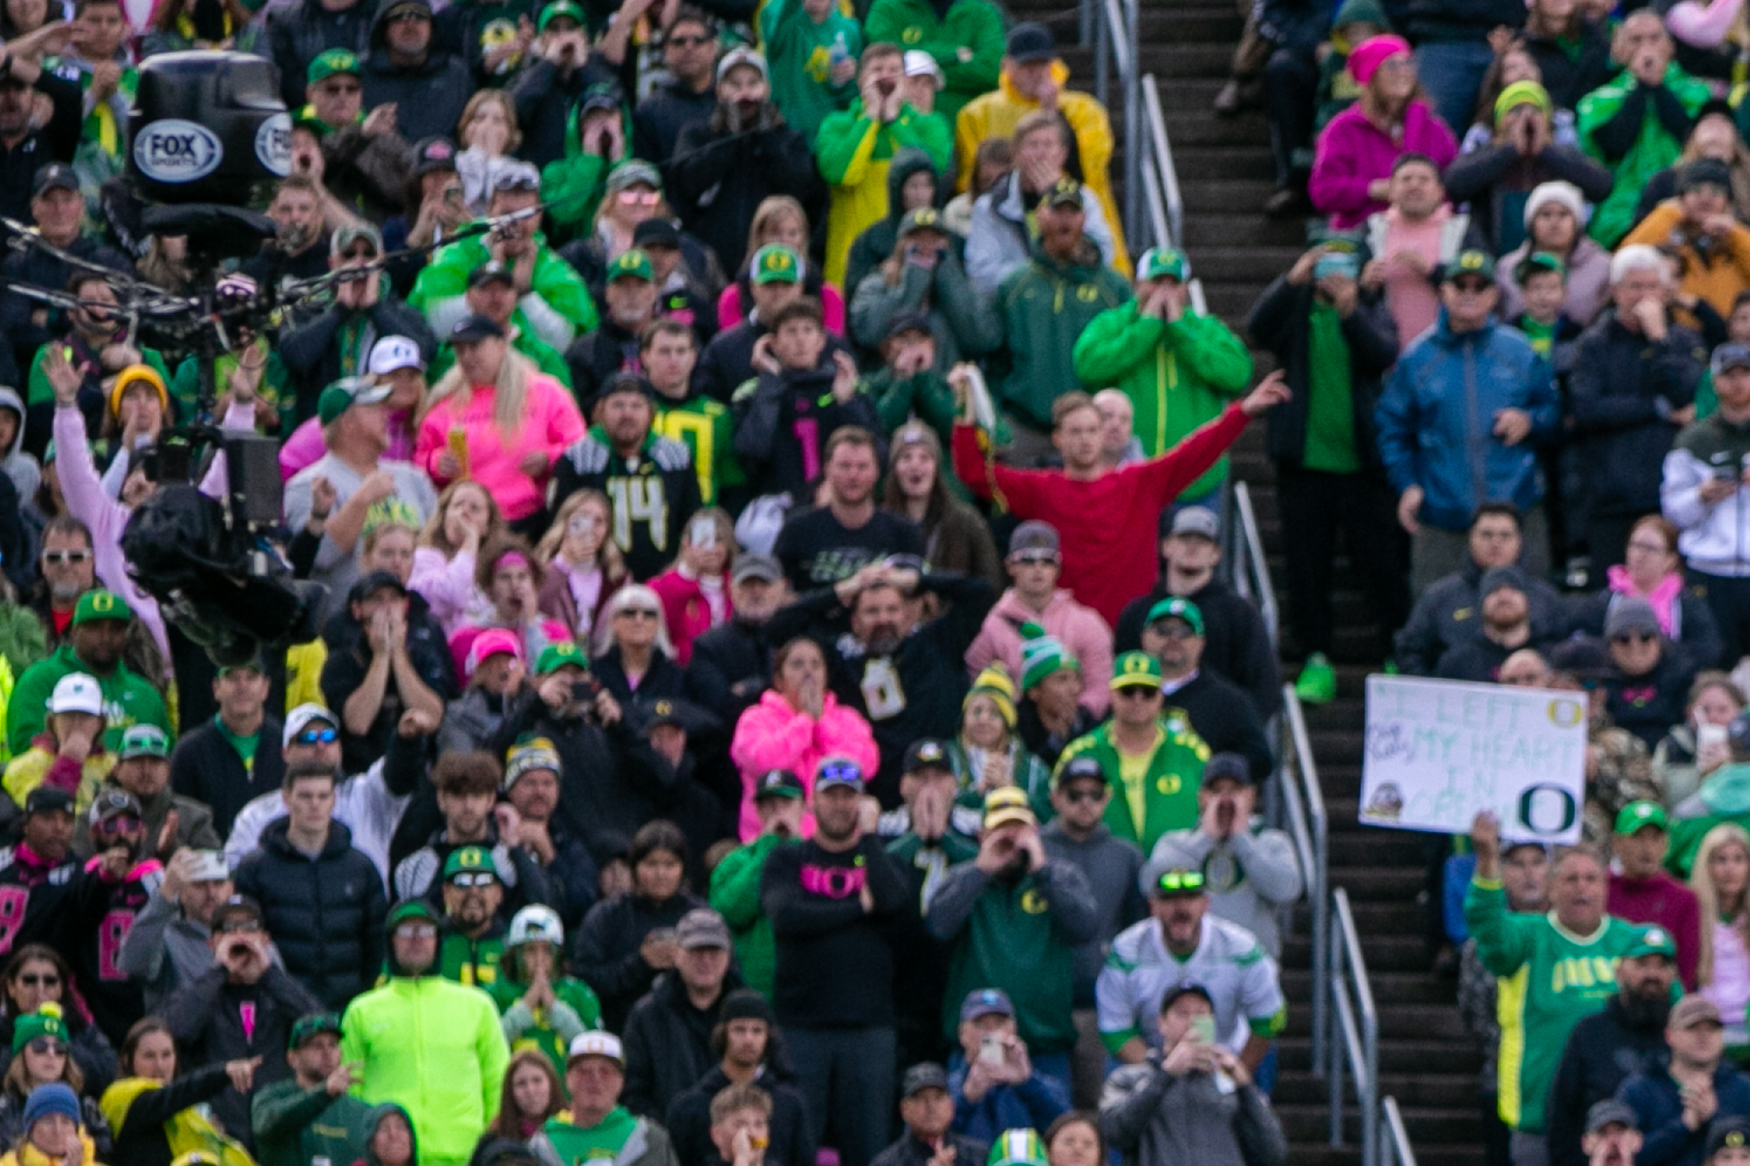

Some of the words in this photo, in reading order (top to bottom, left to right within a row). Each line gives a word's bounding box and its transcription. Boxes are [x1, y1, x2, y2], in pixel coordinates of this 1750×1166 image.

[151, 133, 196, 157] FOX
[606, 474, 669, 553] 14
[1436, 692, 1534, 731] LEFT
[1413, 725, 1459, 763] MY
[1469, 733, 1580, 776] HEART
[1438, 766, 1497, 798] IN
[1518, 783, 1577, 835] O
